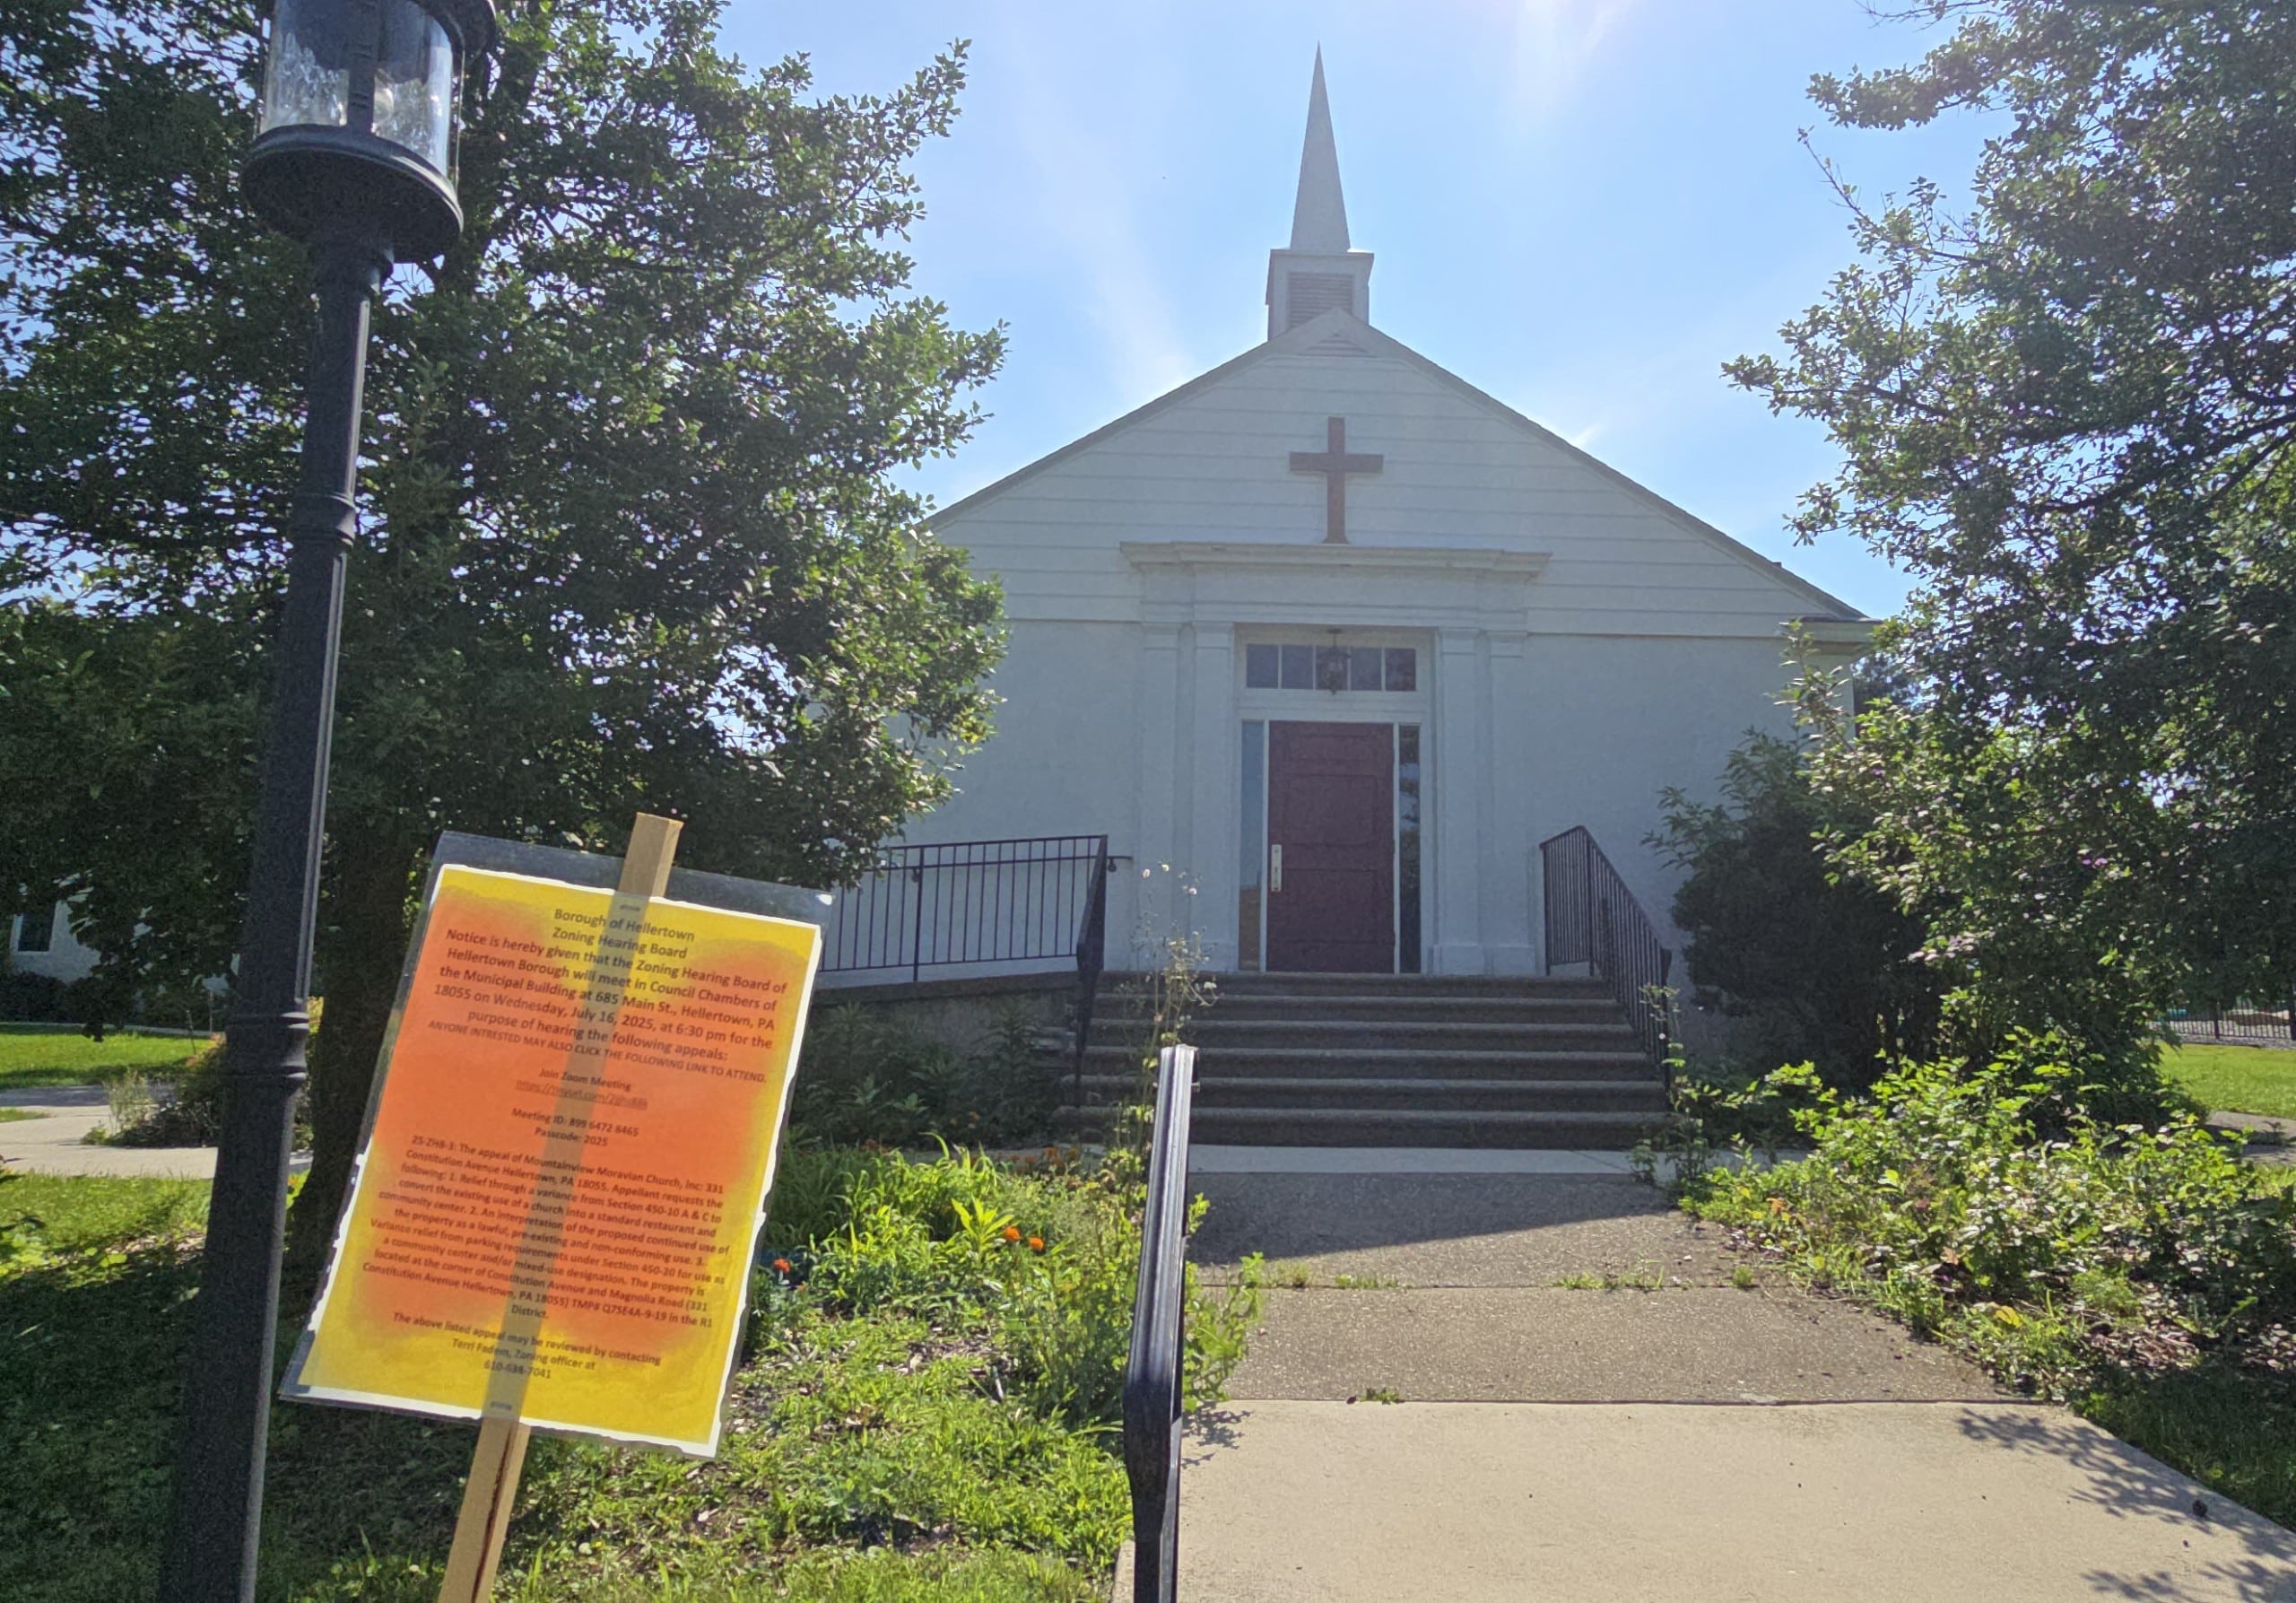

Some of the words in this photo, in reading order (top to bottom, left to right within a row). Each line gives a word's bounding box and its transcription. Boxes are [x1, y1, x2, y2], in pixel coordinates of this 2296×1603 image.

[552, 927, 595, 946] Zoning
[597, 934, 647, 954] Hearing
[649, 942, 688, 958] Board
[553, 909, 606, 928] Borough
[608, 919, 623, 928] of
[625, 920, 695, 940] Hellertown
[446, 928, 487, 945] Notice
[489, 936, 499, 946] is
[501, 937, 544, 956] hereby
[545, 946, 580, 960] given
[583, 951, 610, 964] that
[612, 955, 633, 968] the
[636, 960, 679, 979] Zoning
[682, 967, 729, 987] Hearing
[733, 975, 770, 990] Board
[772, 982, 787, 993] of
[446, 947, 515, 968] Hellertown
[517, 959, 570, 979] Borough
[571, 969, 596, 981] will
[598, 974, 631, 987] meet
[634, 978, 647, 989] in
[649, 980, 695, 998] Council
[697, 988, 760, 1008] Chambers
[762, 1000, 777, 1010] of
[433, 983, 472, 999] 18055
[473, 993, 490, 1002] on
[491, 993, 567, 1017] Wednesday,
[570, 1006, 596, 1023] July
[599, 1010, 617, 1025] 16,
[622, 1014, 657, 1032] 2025,
[659, 1022, 674, 1032] at
[675, 1023, 704, 1037] 6:30
[705, 1031, 726, 1041] pm
[729, 1032, 748, 1044] for
[751, 1035, 772, 1049] the
[439, 965, 460, 979] the
[463, 970, 524, 989] Municipal
[526, 980, 576, 1000] Building
[578, 989, 592, 999] at
[595, 991, 619, 1004] 685
[622, 996, 655, 1010] Main
[657, 1001, 676, 1015] St.,
[681, 1005, 752, 1028] Hellertown,
[757, 1017, 776, 1030] PA
[427, 1020, 468, 1034] ANYONE
[523, 1036, 545, 1047] MAY
[547, 1040, 573, 1051] ALSO
[574, 1044, 600, 1056] CLICK
[603, 1049, 622, 1059] THE
[625, 1052, 684, 1069] FOLLOWING
[685, 1061, 708, 1073] LINK
[710, 1066, 724, 1076] TO
[466, 1012, 517, 1026] purpose
[520, 1018, 535, 1029] of
[536, 1020, 584, 1040] hearing
[587, 1028, 608, 1041] the
[612, 1032, 672, 1054] following
[674, 1045, 728, 1060] appeals:
[538, 1068, 558, 1079] Join
[561, 1072, 587, 1084] Zoom
[589, 1076, 631, 1093] Meeting
[511, 1108, 551, 1124] Meeting
[584, 1135, 608, 1146] 2025
[405, 1149, 463, 1167] Constitution
[465, 1159, 500, 1173] Avenue
[501, 1166, 557, 1184] Hellertown,
[560, 1176, 575, 1186] PA
[612, 1184, 660, 1198] Appellant
[661, 1193, 704, 1206] requests
[706, 1198, 723, 1208] the
[457, 1144, 476, 1154] The
[478, 1149, 509, 1159] appeal
[511, 1154, 522, 1162] of
[523, 1154, 595, 1173] Mountainview
[596, 1166, 643, 1181] Moravian
[646, 1173, 682, 1189] Church,
[459, 1172, 487, 1186] Relief
[488, 1178, 526, 1194] through
[536, 1189, 578, 1200] variance
[580, 1193, 604, 1205] from
[606, 1198, 643, 1211] Section
[378, 1192, 431, 1209] community
[496, 1210, 563, 1229] interpretation
[578, 1224, 595, 1234] the
[596, 1229, 645, 1241] proposed
[646, 1236, 697, 1250] continued
[699, 1243, 716, 1252] use
[394, 1208, 410, 1218] the
[411, 1213, 454, 1228] property
[510, 1230, 568, 1247] pre-existing
[570, 1239, 589, 1248] and
[397, 1180, 434, 1192] convert
[435, 1185, 451, 1195] the
[453, 1189, 490, 1204] existing
[531, 1202, 564, 1214] church
[566, 1207, 586, 1217] into
[596, 1212, 641, 1225] standard
[642, 1220, 695, 1234] restaurant
[697, 1228, 717, 1237] and
[370, 1218, 410, 1233] Variance
[413, 1227, 439, 1238] relief
[439, 1230, 463, 1242] from
[465, 1237, 501, 1250] parking
[503, 1243, 569, 1260] requirements
[570, 1255, 600, 1265] under
[602, 1258, 639, 1271] Section
[391, 1240, 445, 1256] community
[447, 1249, 478, 1259] center
[480, 1255, 511, 1266] and/or
[514, 1259, 564, 1274] mixed-use
[630, 1276, 648, 1287] The
[650, 1282, 694, 1296] property
[361, 1262, 422, 1280] Constitution
[423, 1273, 459, 1287] Avenue
[373, 1249, 411, 1263] located
[423, 1258, 439, 1268] the
[441, 1263, 473, 1274] corner
[487, 1268, 545, 1286] Constitution
[548, 1280, 585, 1293] Avenue
[587, 1287, 607, 1296] and
[608, 1288, 656, 1303] Magnolia
[657, 1295, 683, 1308] Road
[393, 1312, 411, 1324] The
[413, 1317, 441, 1329] above
[444, 1321, 471, 1334] listed
[473, 1329, 506, 1340] appeal
[507, 1334, 528, 1346] may
[545, 1340, 592, 1354] reviewed
[608, 1350, 661, 1367] contacting
[514, 1348, 548, 1364] Zoning
[551, 1355, 582, 1368] officer
